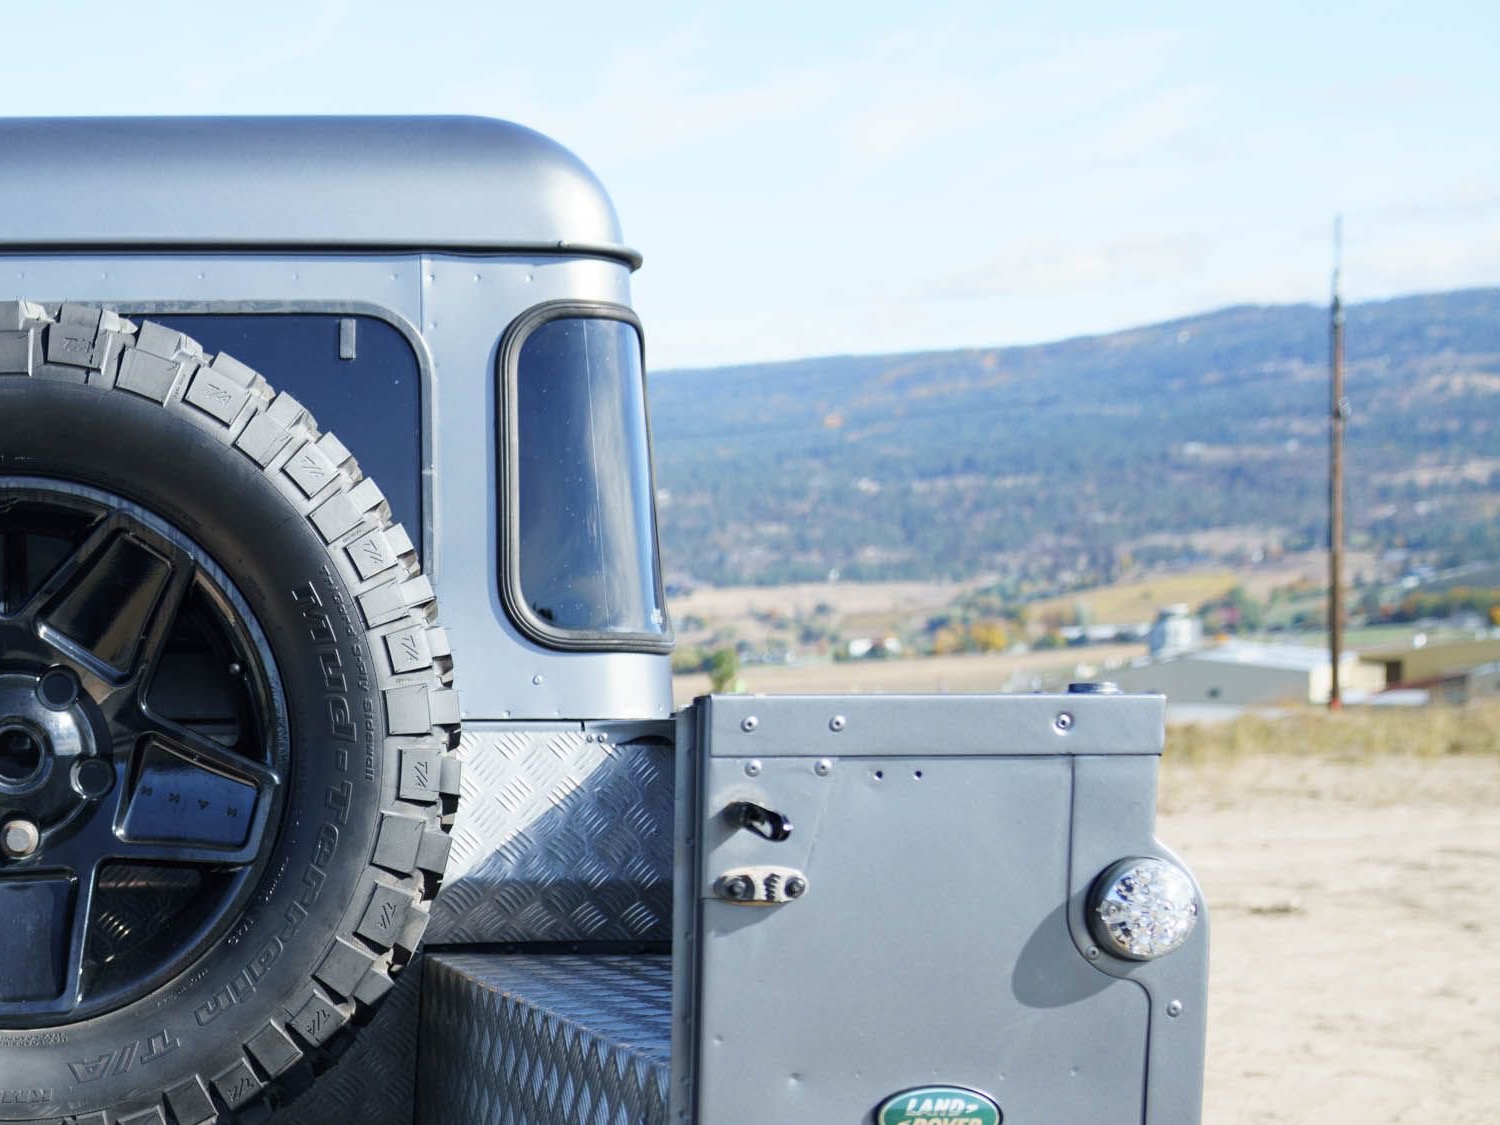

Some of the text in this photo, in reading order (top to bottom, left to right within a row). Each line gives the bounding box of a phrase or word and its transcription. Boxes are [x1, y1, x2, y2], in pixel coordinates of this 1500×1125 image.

[361, 697, 377, 783] Sidewall
[68, 1027, 183, 1085] T/A
[905, 1098, 966, 1116] LAND
